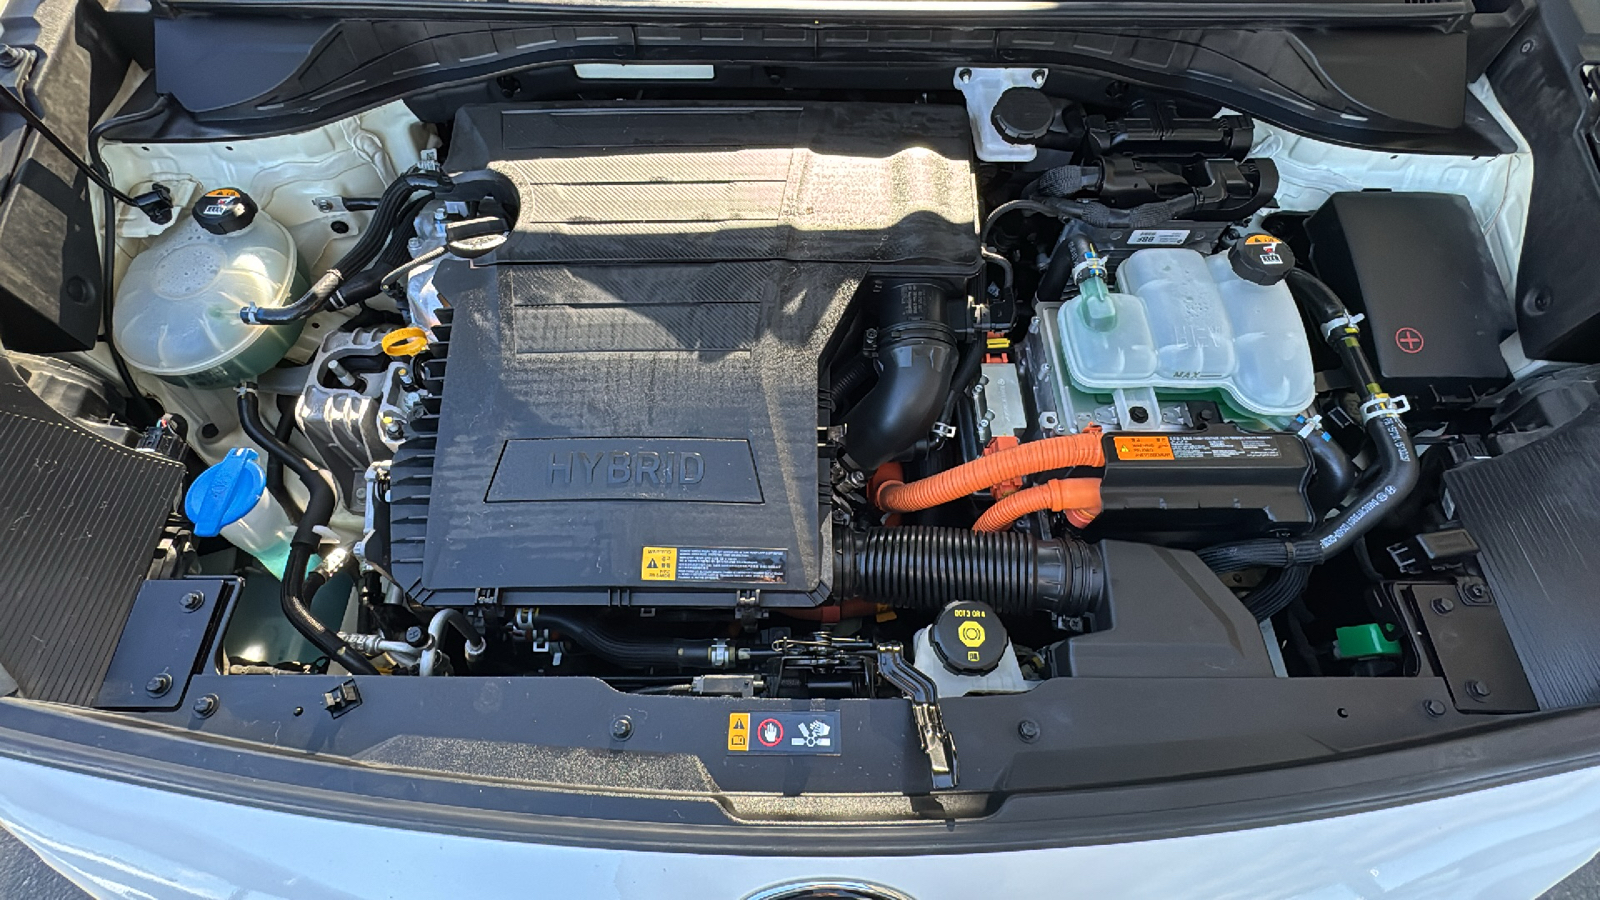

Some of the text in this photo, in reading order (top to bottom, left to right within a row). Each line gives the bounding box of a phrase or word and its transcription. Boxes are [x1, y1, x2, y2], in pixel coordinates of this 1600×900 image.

[1173, 371, 1200, 379] MAX
[549, 451, 705, 485] HYBRID
[954, 609, 966, 617] DOT
[971, 610, 981, 618] OR
